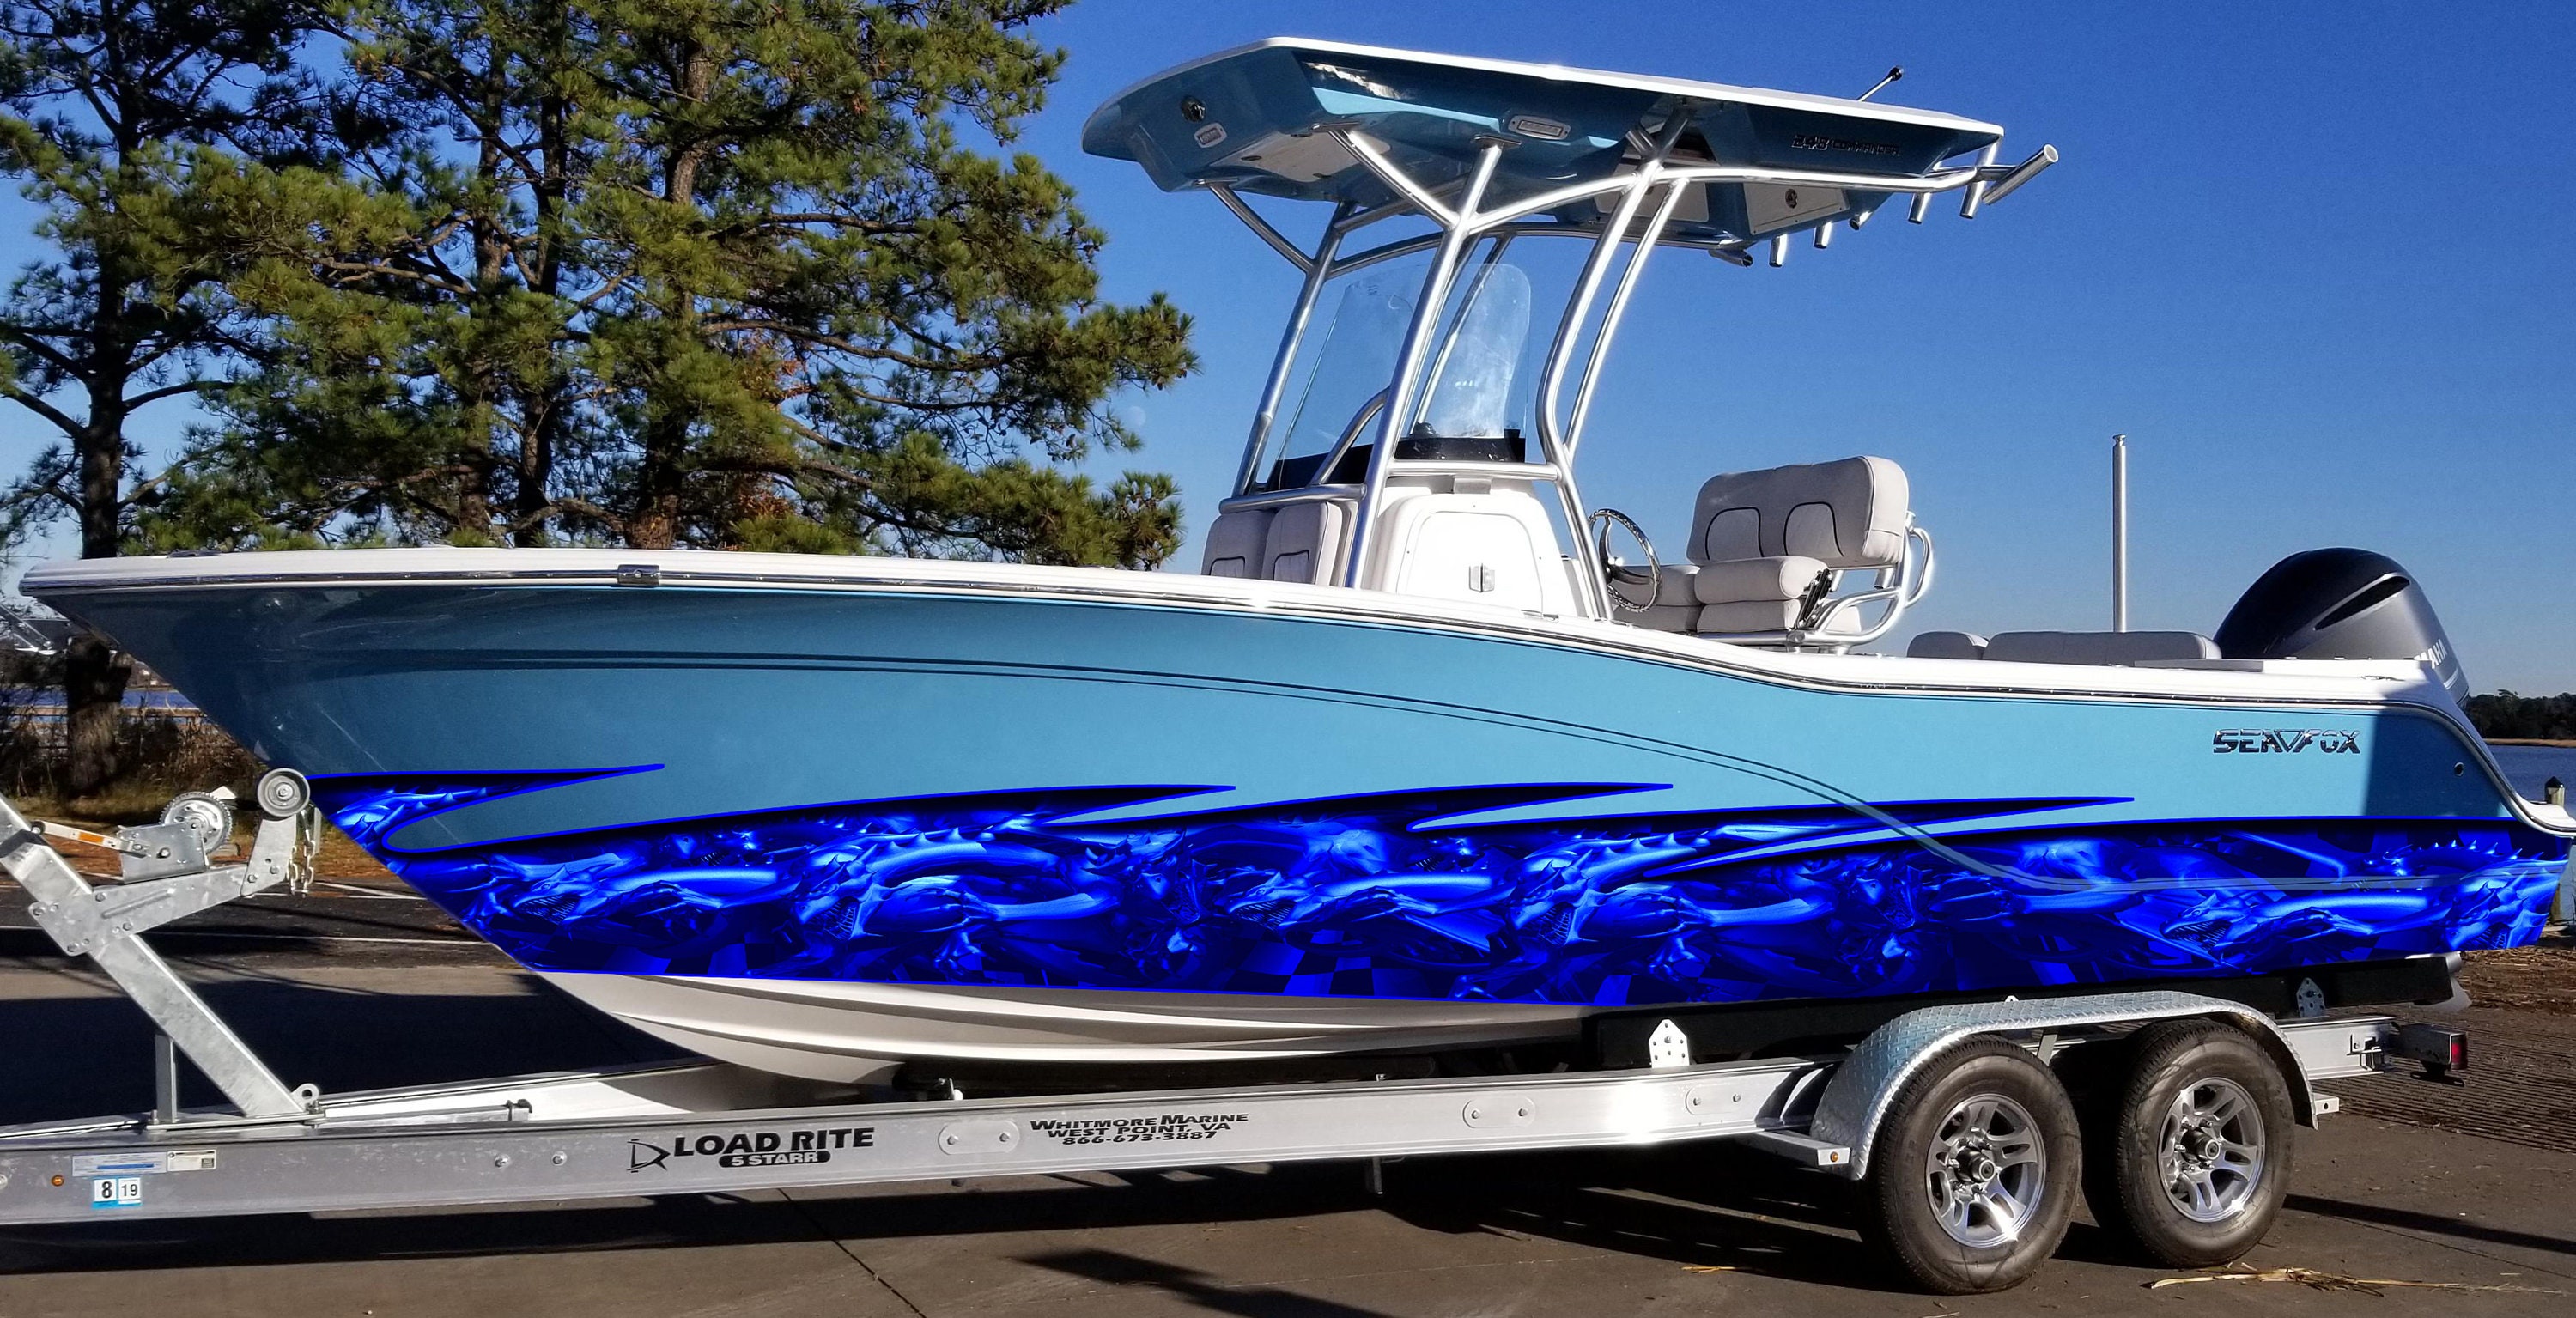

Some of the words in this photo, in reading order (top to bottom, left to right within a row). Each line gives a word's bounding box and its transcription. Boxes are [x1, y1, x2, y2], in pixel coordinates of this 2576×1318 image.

[1030, 1118, 1157, 1130] WHITMORE
[1161, 1114, 1249, 1125] MARINE
[1048, 1128, 1109, 1138] WEST
[1117, 1124, 1192, 1134] POINT,
[1200, 1122, 1231, 1131] VA
[674, 1133, 781, 1157] LOAD
[791, 1127, 874, 1151] RITE
[1062, 1131, 1218, 1145] 866-673-3887
[732, 1155, 744, 1166] 5
[748, 1151, 818, 1165] STARR
[101, 1181, 112, 1199] 8
[121, 1184, 138, 1197] 19
